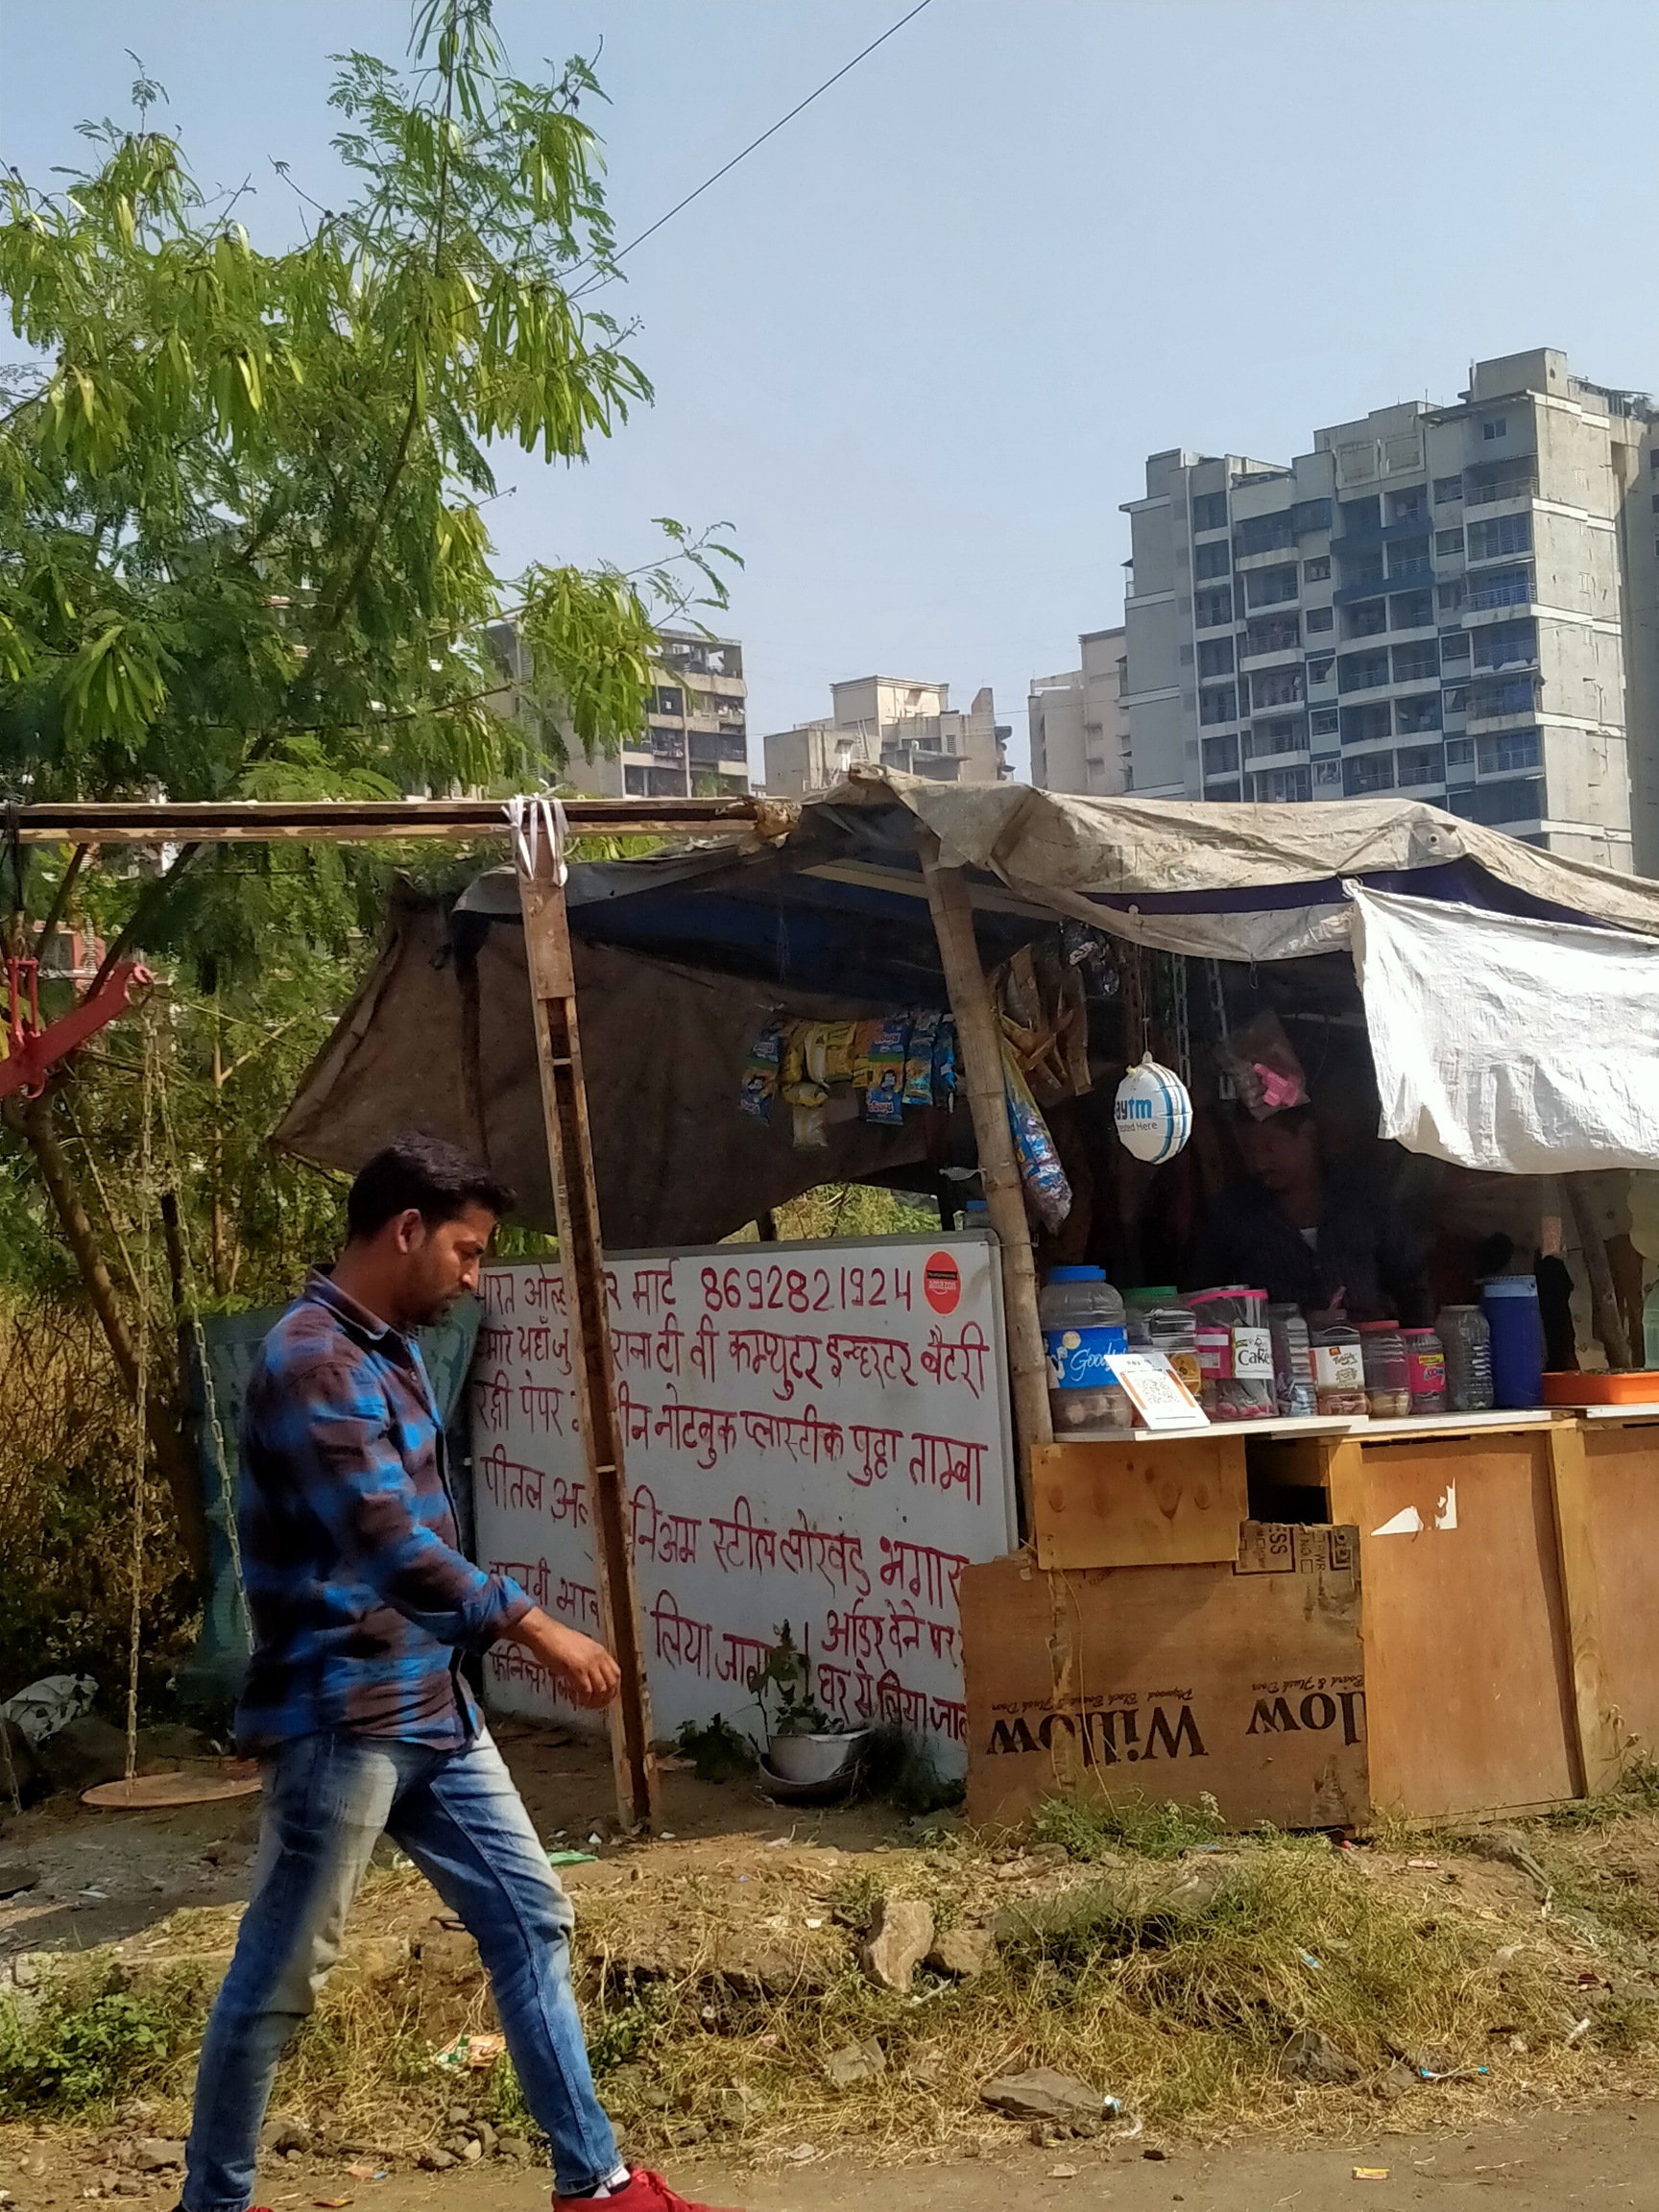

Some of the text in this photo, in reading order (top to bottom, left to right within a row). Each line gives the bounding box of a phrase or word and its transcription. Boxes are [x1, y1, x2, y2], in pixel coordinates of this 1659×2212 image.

[1117, 1097, 1152, 1120] aytm
[1136, 1121, 1158, 1131] Here
[701, 1265, 911, 1313] 8692821924
[1238, 1347, 1271, 1367] Cake
[519, 1369, 565, 1436] पेपर
[480, 1443, 545, 1511] पीतल
[650, 1589, 712, 1680] लिया
[1245, 1692, 1365, 1746] low
